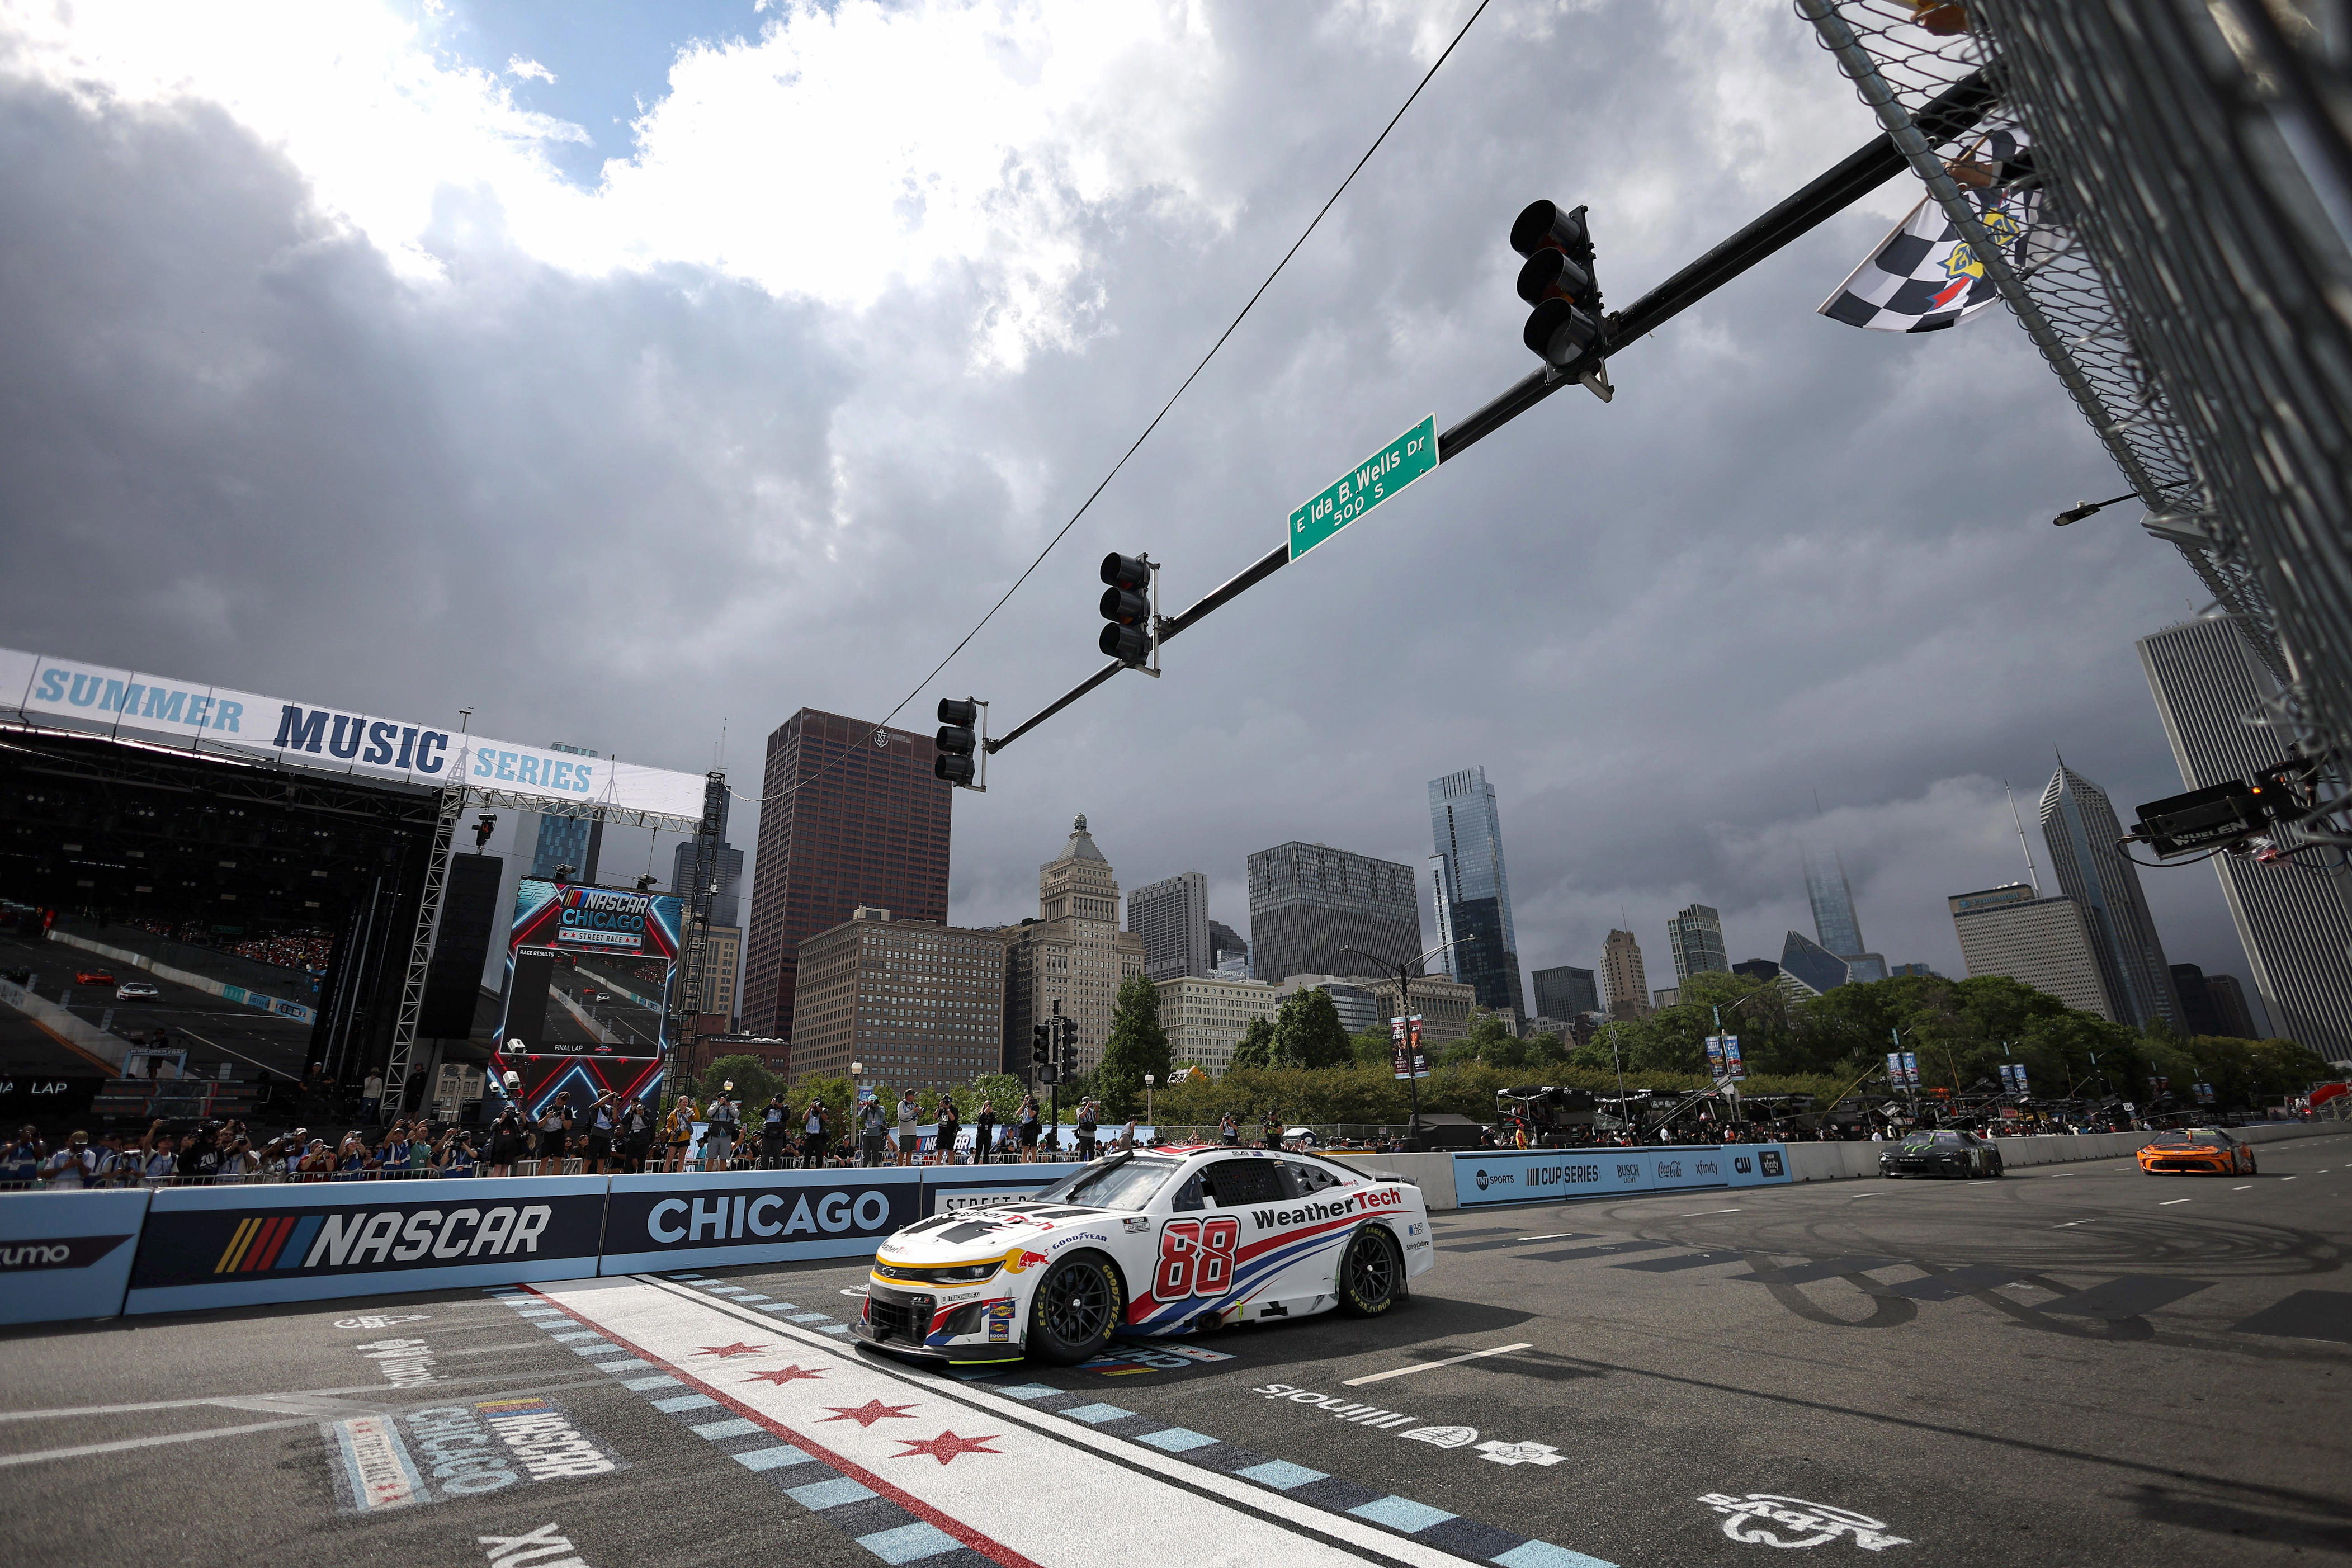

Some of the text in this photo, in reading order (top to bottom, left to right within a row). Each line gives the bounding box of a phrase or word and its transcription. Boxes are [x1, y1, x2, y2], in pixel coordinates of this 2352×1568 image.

[1297, 436, 1425, 533] E Ida B. Wells Dr
[1334, 483, 1384, 526] 500 S
[35, 668, 593, 794] SUMMER MUSIC SERIES
[2170, 818, 2250, 847] WHELEN
[584, 891, 650, 914] NASCAR
[1972, 892, 2018, 905] Prudential
[562, 908, 644, 932] CHICAGO
[579, 932, 604, 942] STREET
[1207, 969, 1245, 977] MOTOROLA
[31, 1083, 67, 1094] LAP
[924, 1135, 971, 1150] NAAR
[1542, 1165, 1598, 1185] CUP SERIES
[1617, 1164, 1639, 1177] BUSCH
[1695, 1161, 1718, 1175] xfinity
[1764, 1160, 1779, 1171] xfinity
[1490, 1175, 1514, 1184] SPORTS
[648, 1190, 890, 1243] CHICAGO
[1251, 1187, 1401, 1229] WeatherTech
[305, 1205, 552, 1267] NASCAR
[1052, 1232, 1108, 1249] GOODYEAR
[1366, 1227, 1386, 1239] EAGLE
[1406, 1240, 1429, 1251] SafetyCulture
[1151, 1215, 1241, 1305] 88
[1038, 1284, 1047, 1326] EAGLE
[1102, 1264, 1120, 1340] GOODYEAR
[1350, 1288, 1391, 1314] GOODYEAR
[1253, 1384, 1416, 1428] Illinois
[353, 1434, 398, 1483] STREET RACE
[405, 1407, 518, 1493] CHICAGO
[488, 1412, 616, 1481] NASCAR
